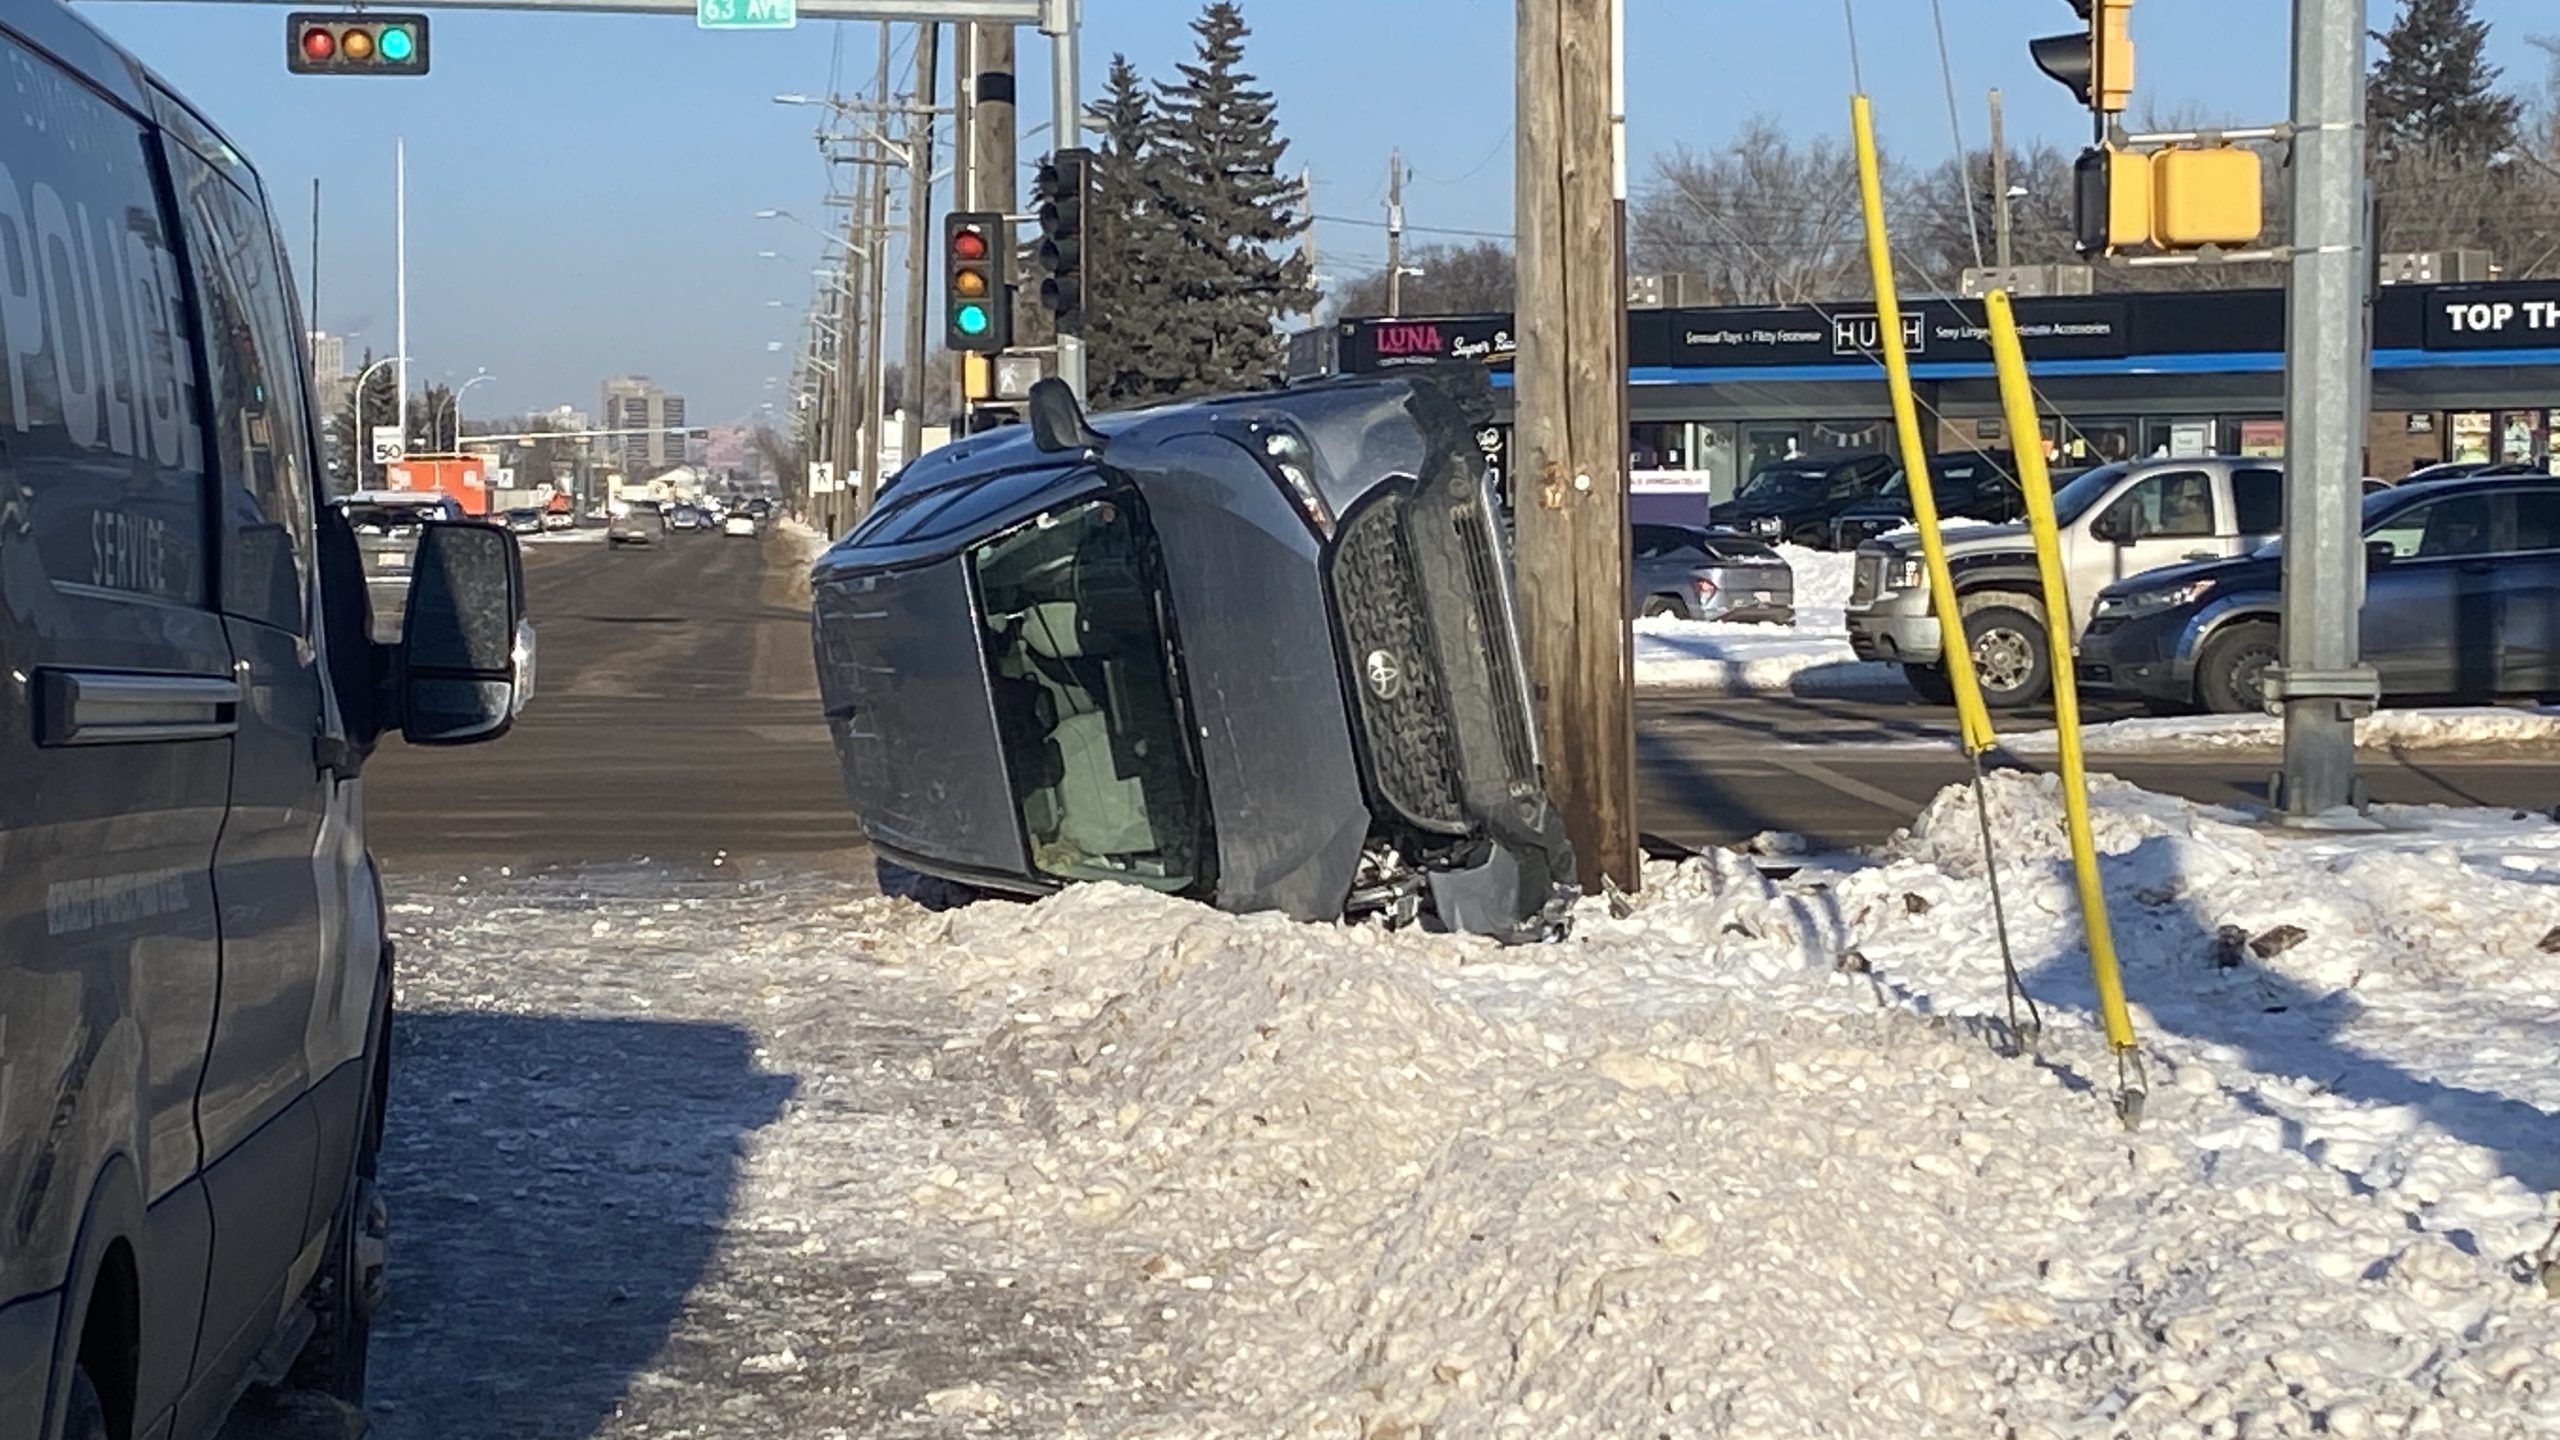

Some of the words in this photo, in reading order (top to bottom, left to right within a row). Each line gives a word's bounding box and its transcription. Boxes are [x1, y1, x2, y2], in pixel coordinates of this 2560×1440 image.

[704, 0, 735, 20] 63
[746, 0, 791, 20] AVE
[0, 162, 204, 474] POLICE
[2445, 303, 2514, 331] TOP
[1376, 325, 1444, 353] LUNA
[1837, 320, 1921, 347] HUH
[1451, 336, 1490, 360] Super
[376, 444, 401, 459] 50
[92, 509, 166, 591] SERVICE
